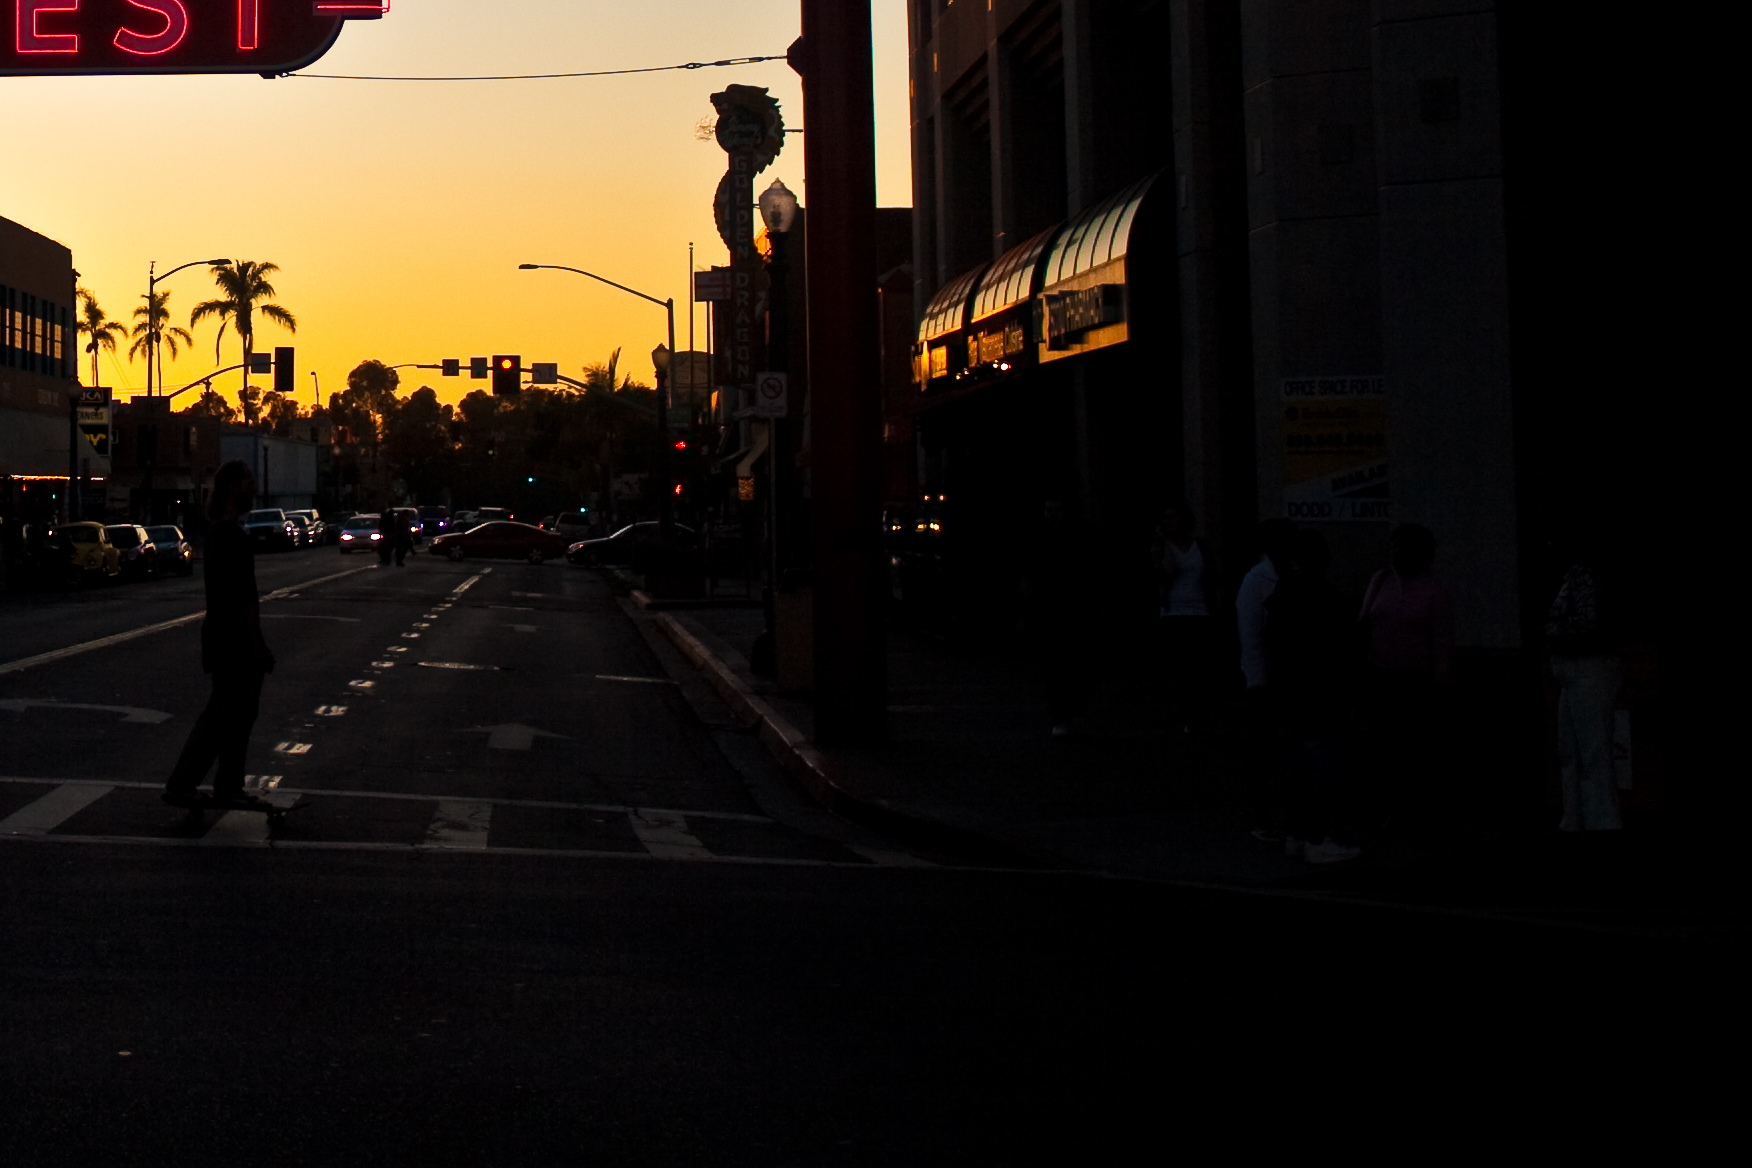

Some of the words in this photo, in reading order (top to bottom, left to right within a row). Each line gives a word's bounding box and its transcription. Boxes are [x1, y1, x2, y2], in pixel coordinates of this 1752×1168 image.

[734, 154, 750, 259] GOLDEN
[735, 270, 750, 379] DRAGON
[1285, 380, 1315, 396] OFFICE
[1318, 379, 1347, 395] SPACE
[1349, 378, 1369, 394] FOR
[1331, 463, 1389, 493] AVAILAB
[1287, 501, 1332, 518] DODD
